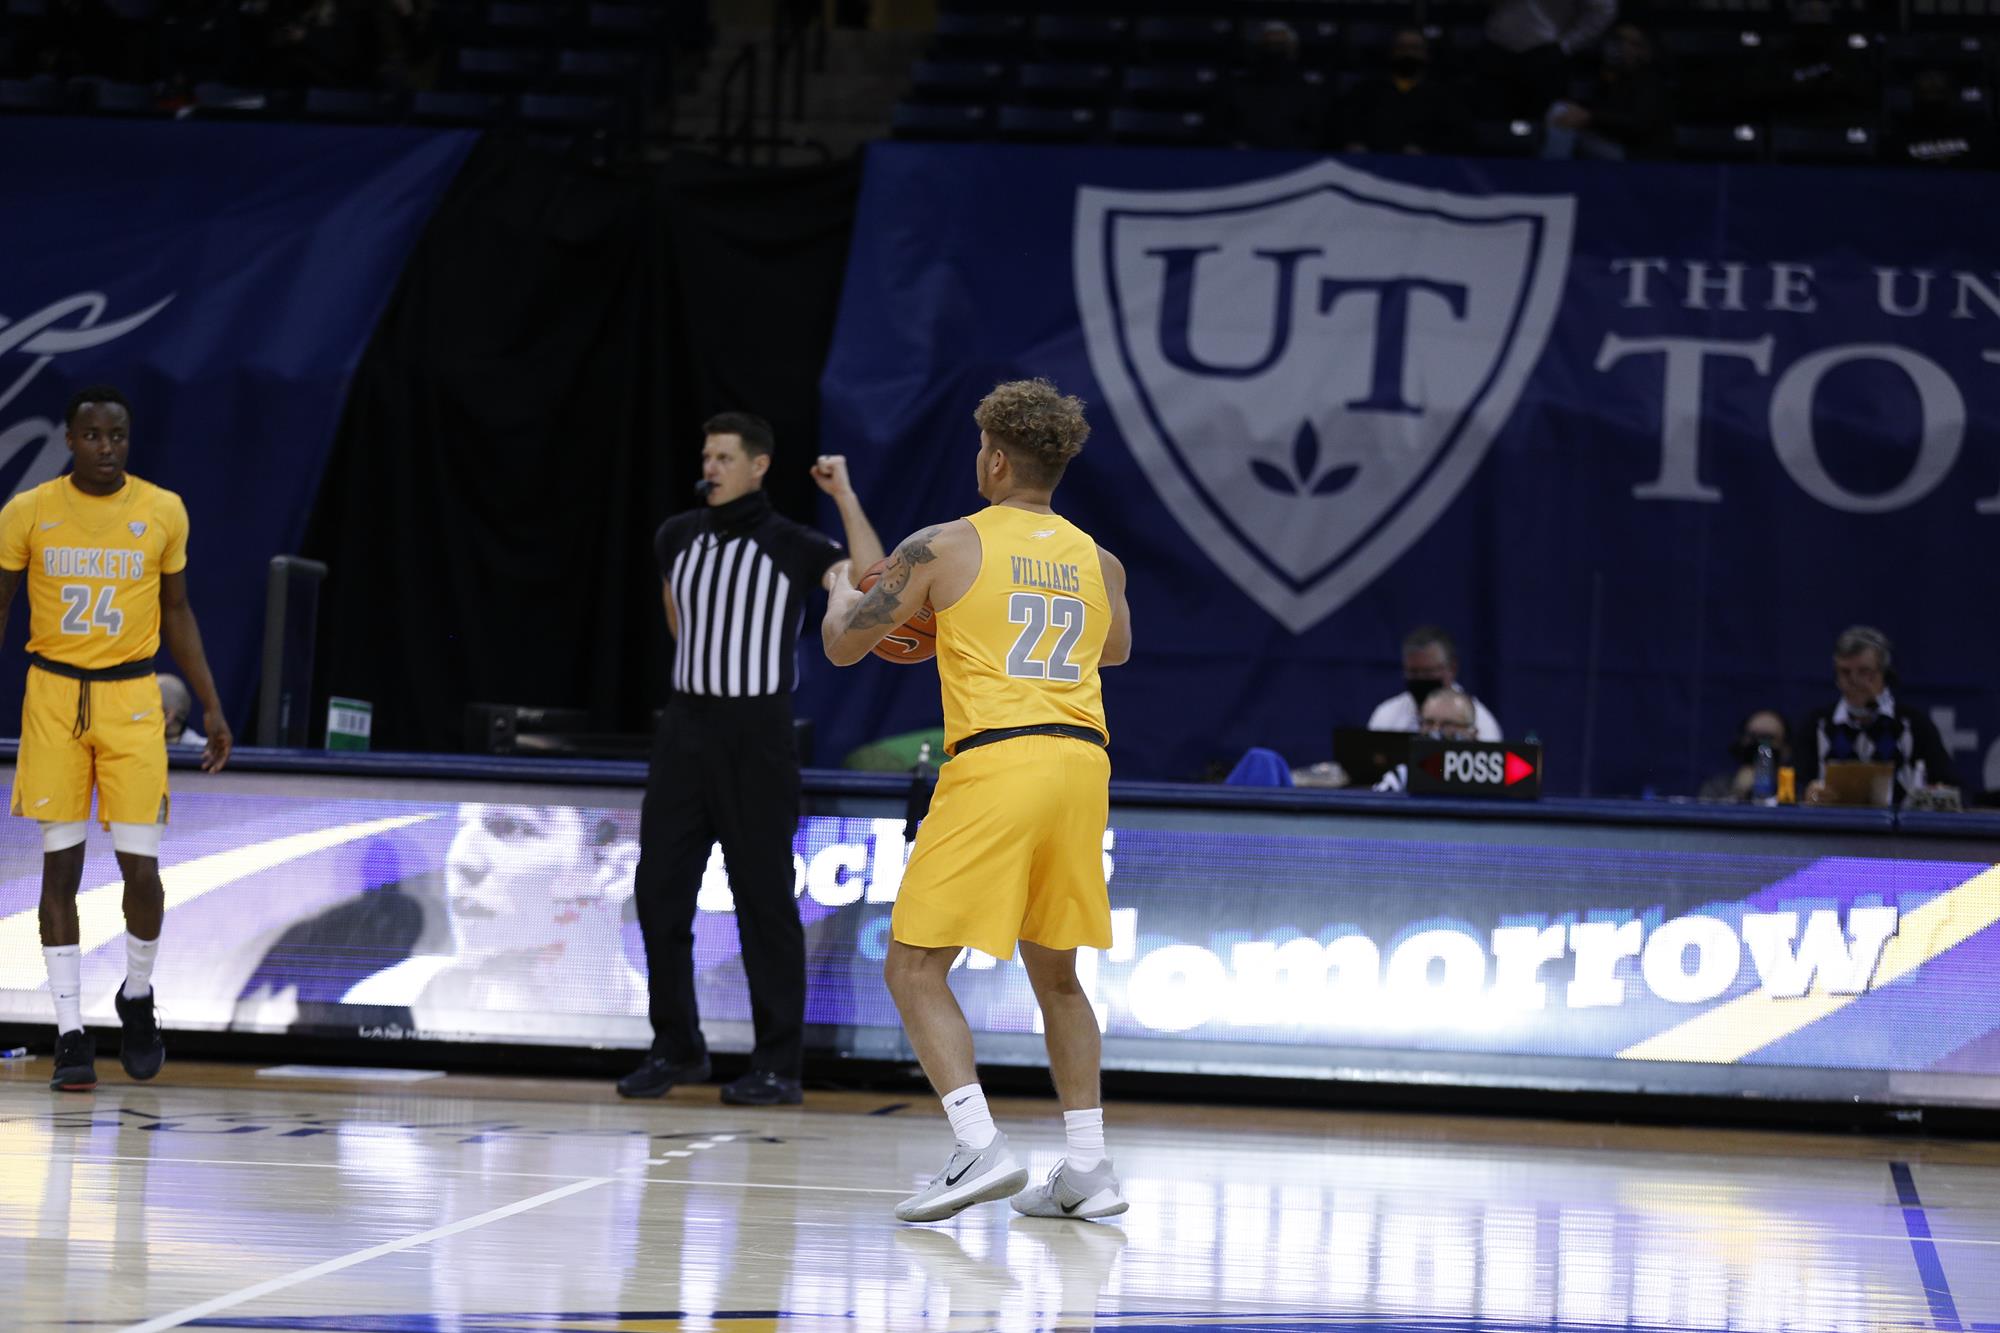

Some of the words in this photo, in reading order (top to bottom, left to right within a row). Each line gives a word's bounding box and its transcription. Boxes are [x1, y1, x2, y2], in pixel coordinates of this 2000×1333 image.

[1610, 257, 1818, 313] THE
[1143, 244, 1468, 417] UT
[1594, 331, 2000, 515] TO
[44, 547, 144, 580] ROCKETS
[1010, 555, 1080, 593] WILLIAMS
[61, 584, 123, 636] 24
[1006, 592, 1084, 683] 22
[1443, 751, 1504, 785] POSS
